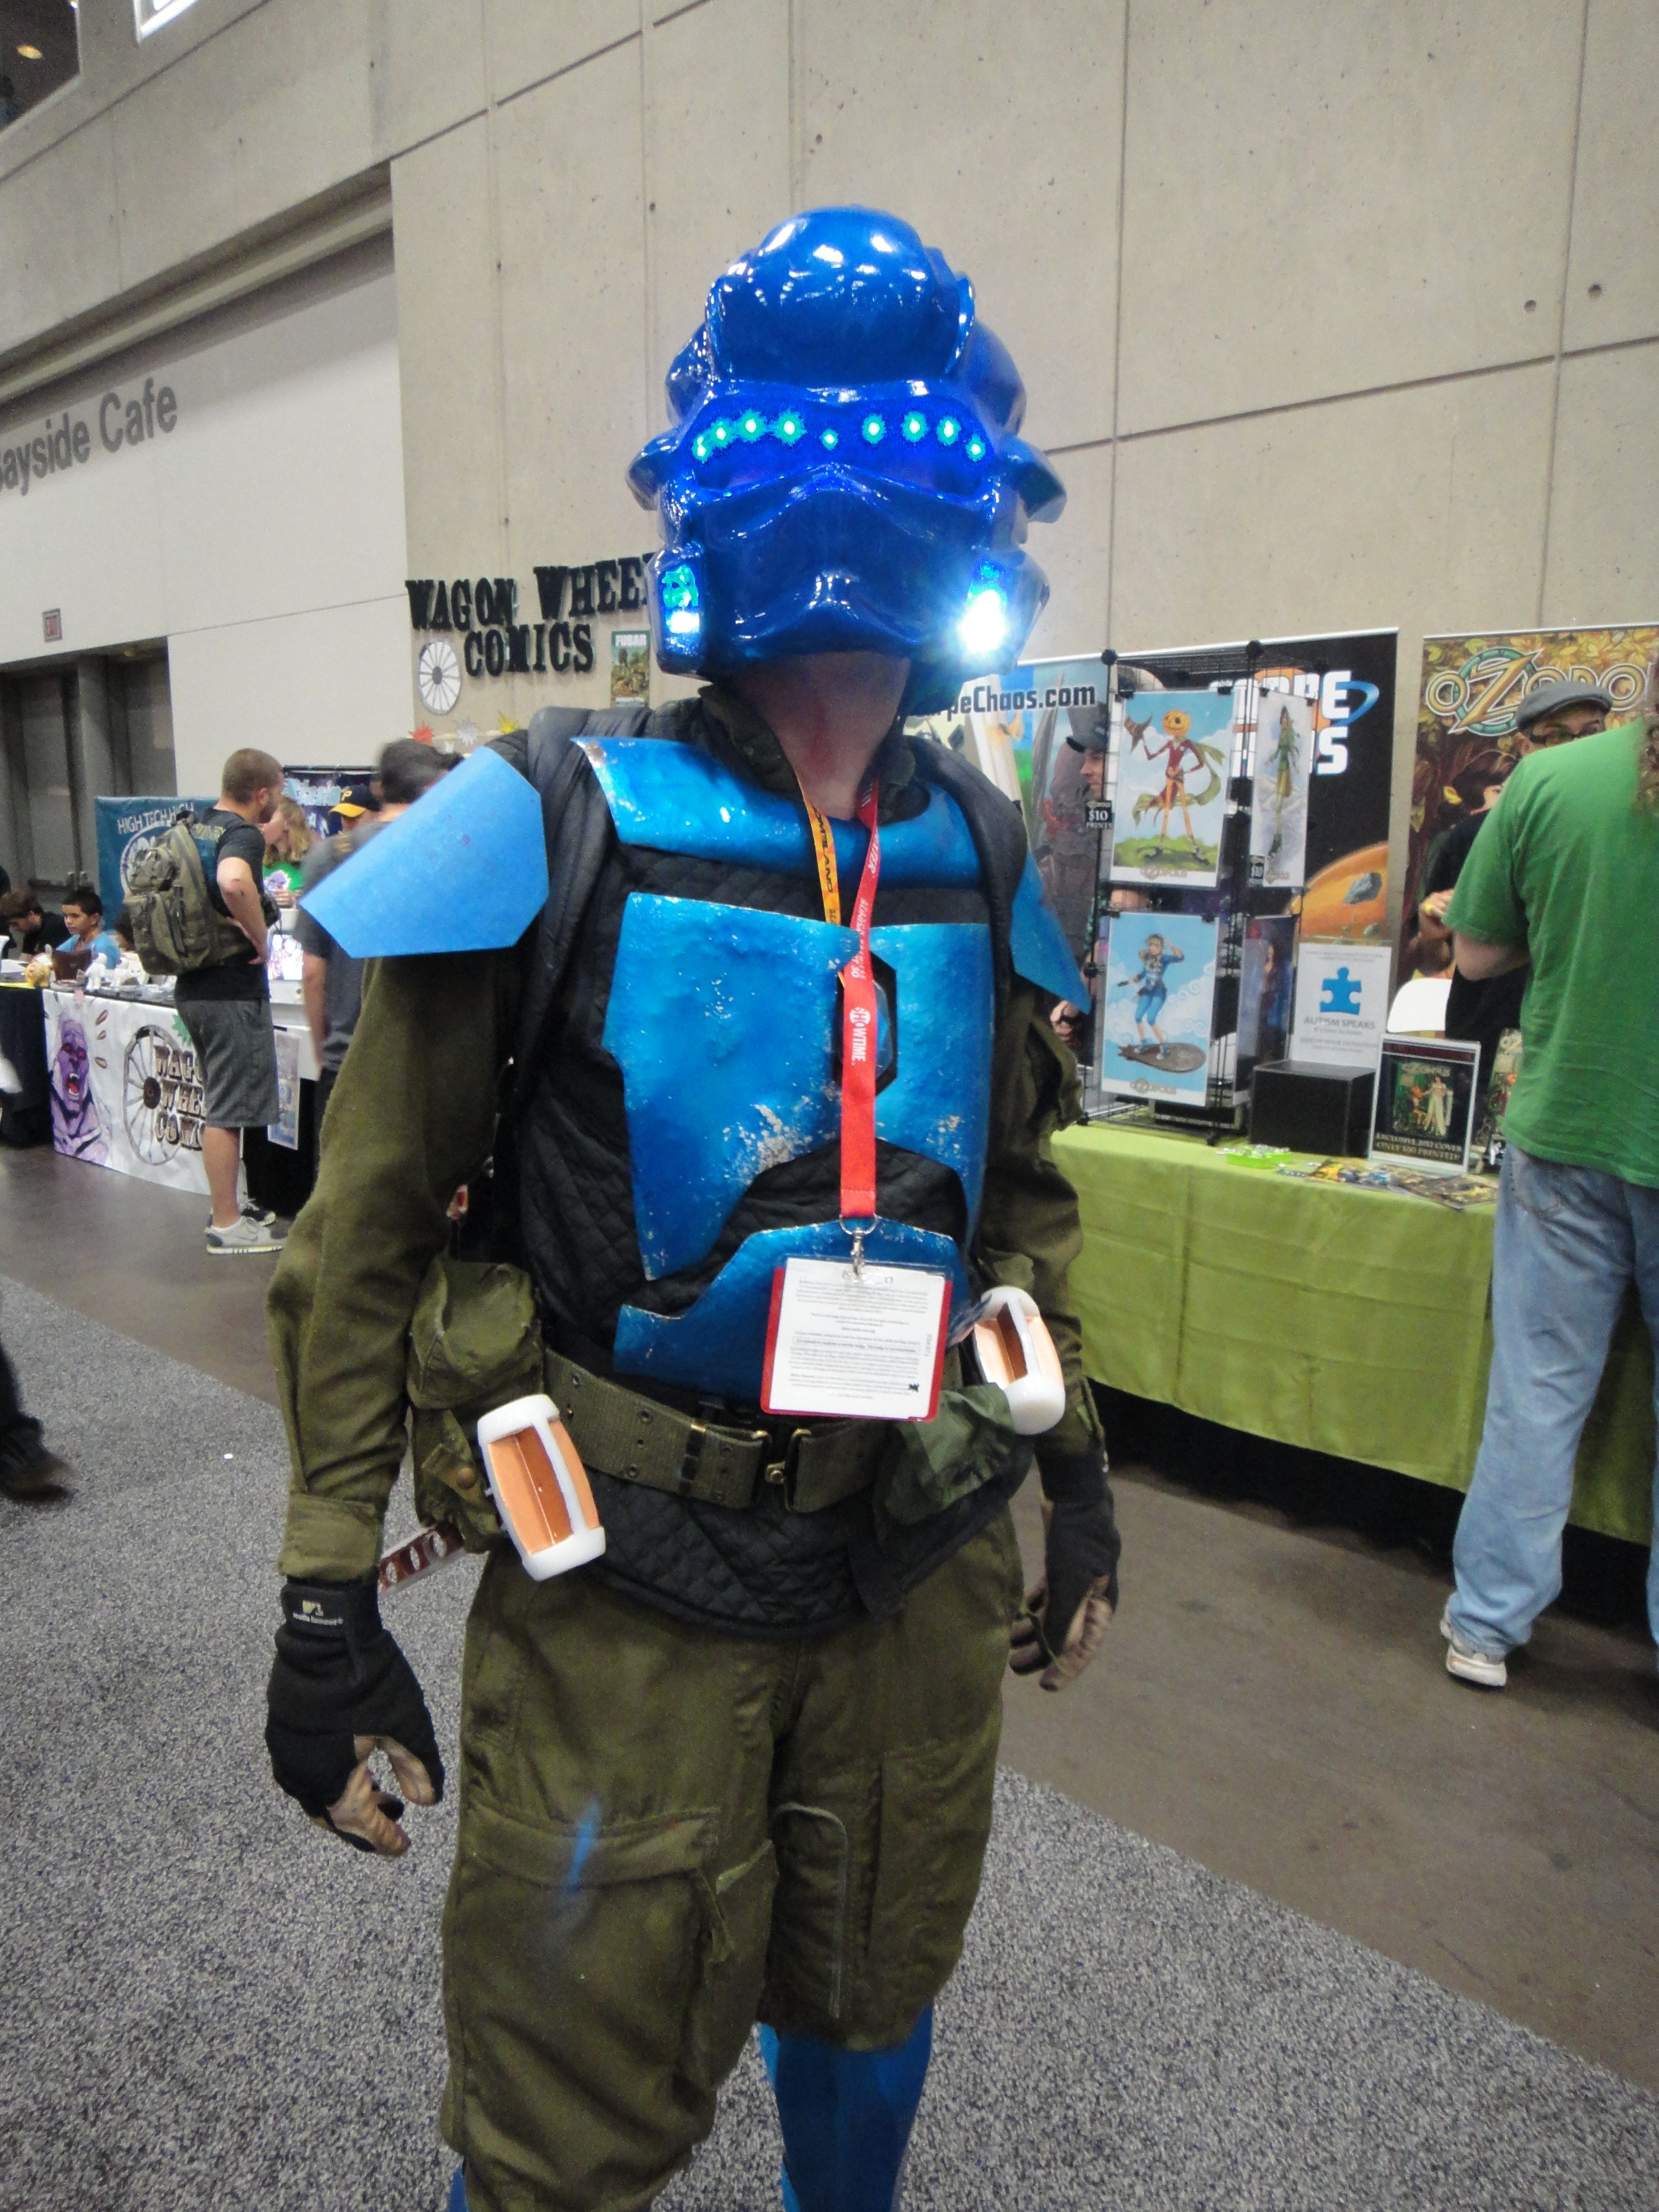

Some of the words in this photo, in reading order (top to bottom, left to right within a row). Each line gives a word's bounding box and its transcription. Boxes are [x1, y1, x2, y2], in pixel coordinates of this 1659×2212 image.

[99, 376, 178, 453] Cafe
[405, 578, 517, 632] WAGON
[533, 552, 654, 620] WHEE
[464, 623, 593, 677] COMICS
[1089, 810, 1109, 822] $10
[849, 1007, 870, 1062] SHOWTIME
